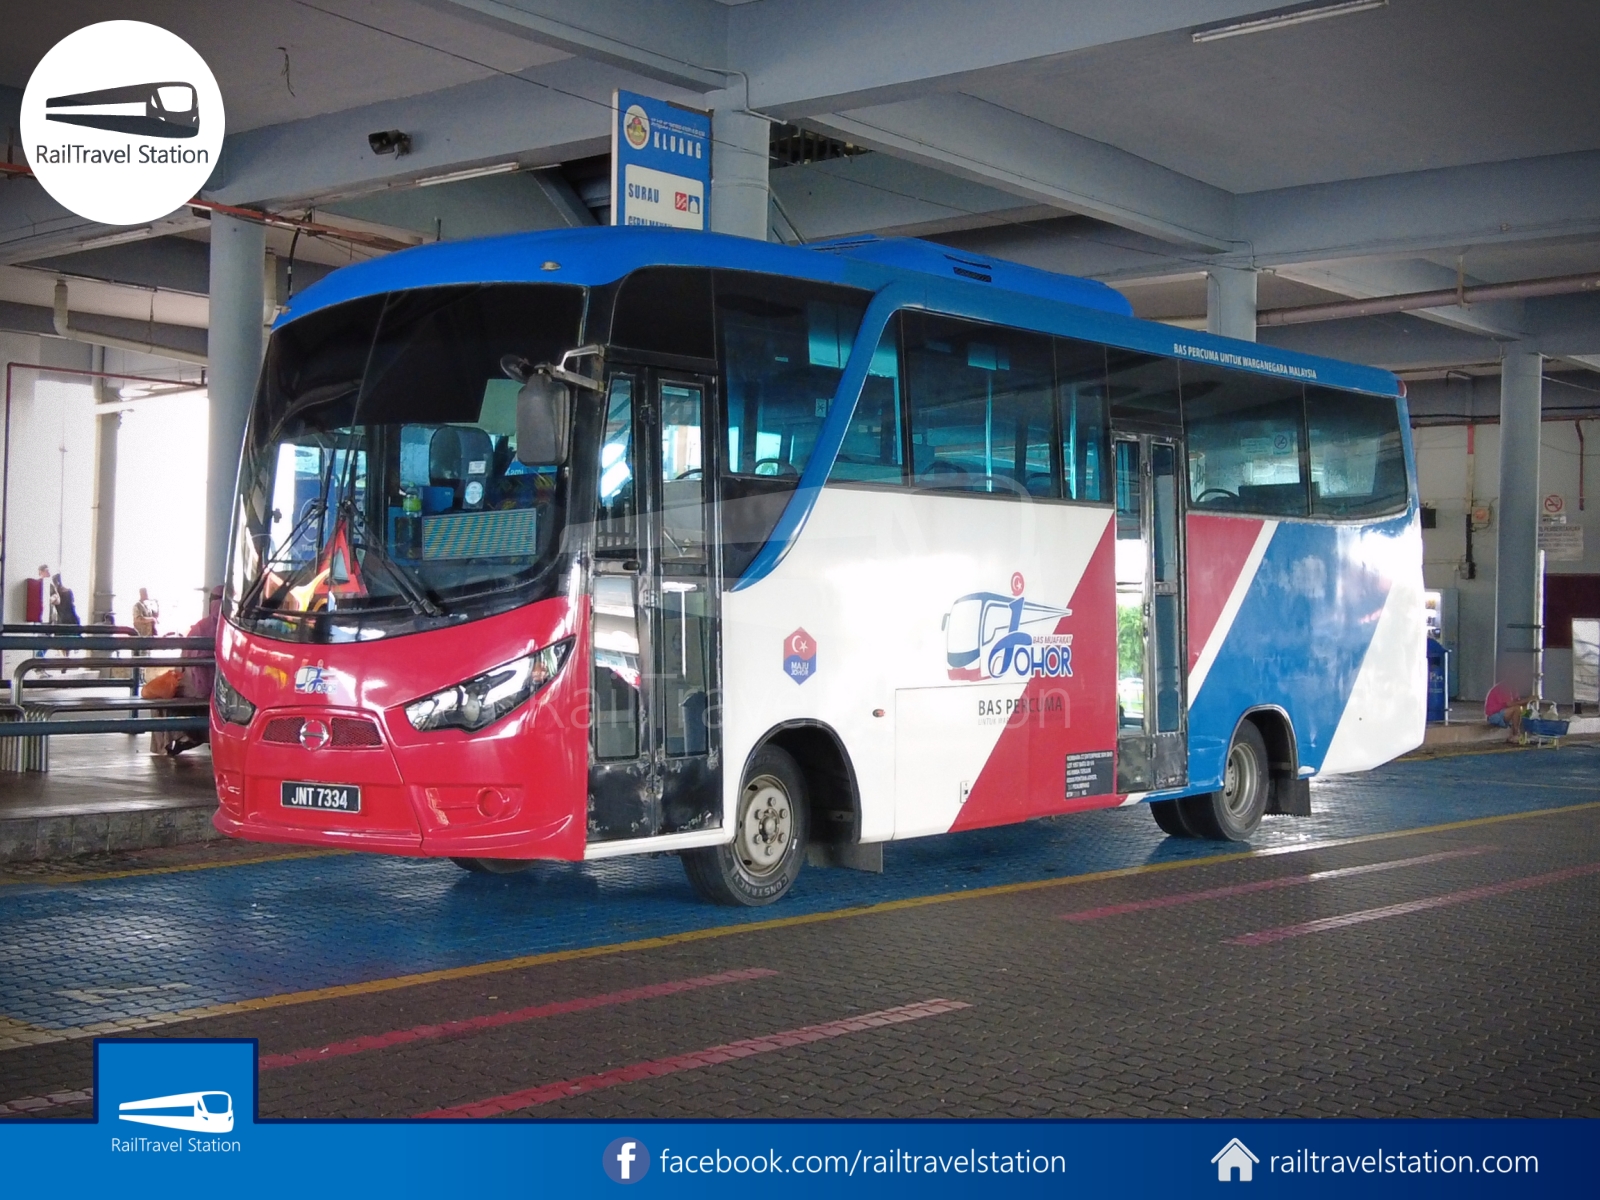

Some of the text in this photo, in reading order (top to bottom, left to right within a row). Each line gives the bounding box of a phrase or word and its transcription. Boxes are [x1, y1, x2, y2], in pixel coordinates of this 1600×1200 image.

[654, 131, 702, 159] KLUANG
[628, 183, 659, 204] SURAU
[1173, 343, 1317, 379] BAS PERCUMA UNTUK WARGANEGARA MALAYSIA
[1033, 635, 1072, 644] BAS MUAFAKAT
[790, 661, 809, 669] MAJU
[790, 669, 809, 677] JOHOR
[978, 699, 1002, 716] BAS
[1006, 696, 1063, 715] PERCUMA
[291, 786, 348, 808] JNT 7334
[733, 874, 788, 897] CONSTANCY
